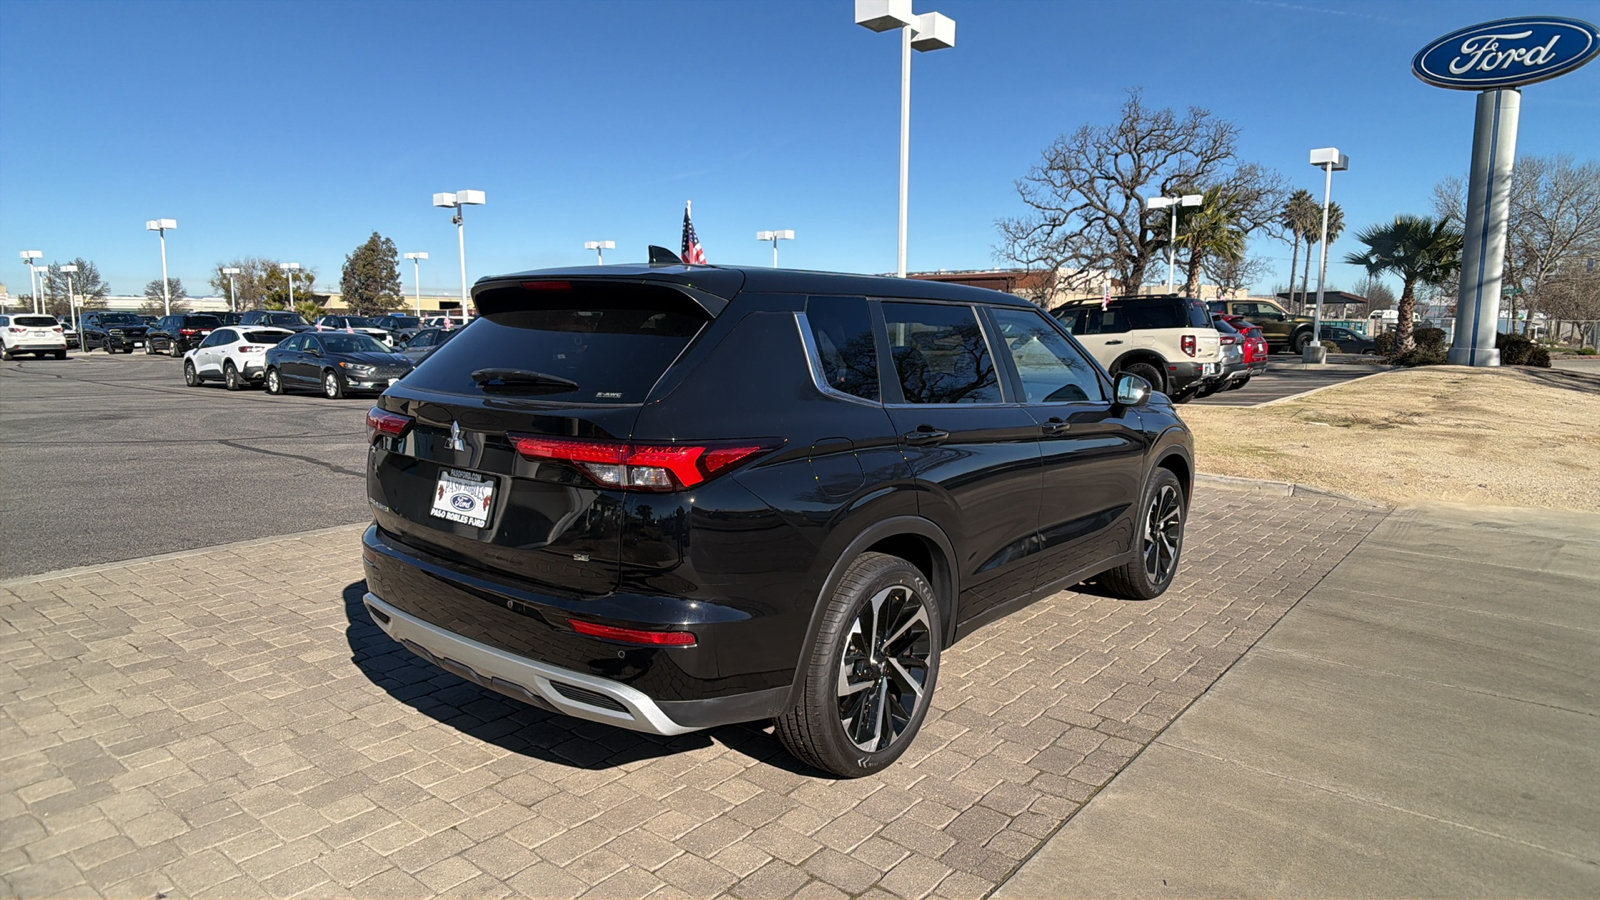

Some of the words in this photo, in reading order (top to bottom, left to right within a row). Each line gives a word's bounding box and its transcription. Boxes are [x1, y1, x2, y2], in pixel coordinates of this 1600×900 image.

[1449, 30, 1561, 75] Ford
[444, 480, 462, 493] PASO
[463, 483, 485, 501] ROBLES
[454, 496, 472, 508] Ford
[430, 508, 446, 518] PASO
[445, 512, 468, 524] ROBLES
[468, 517, 486, 528] FORD
